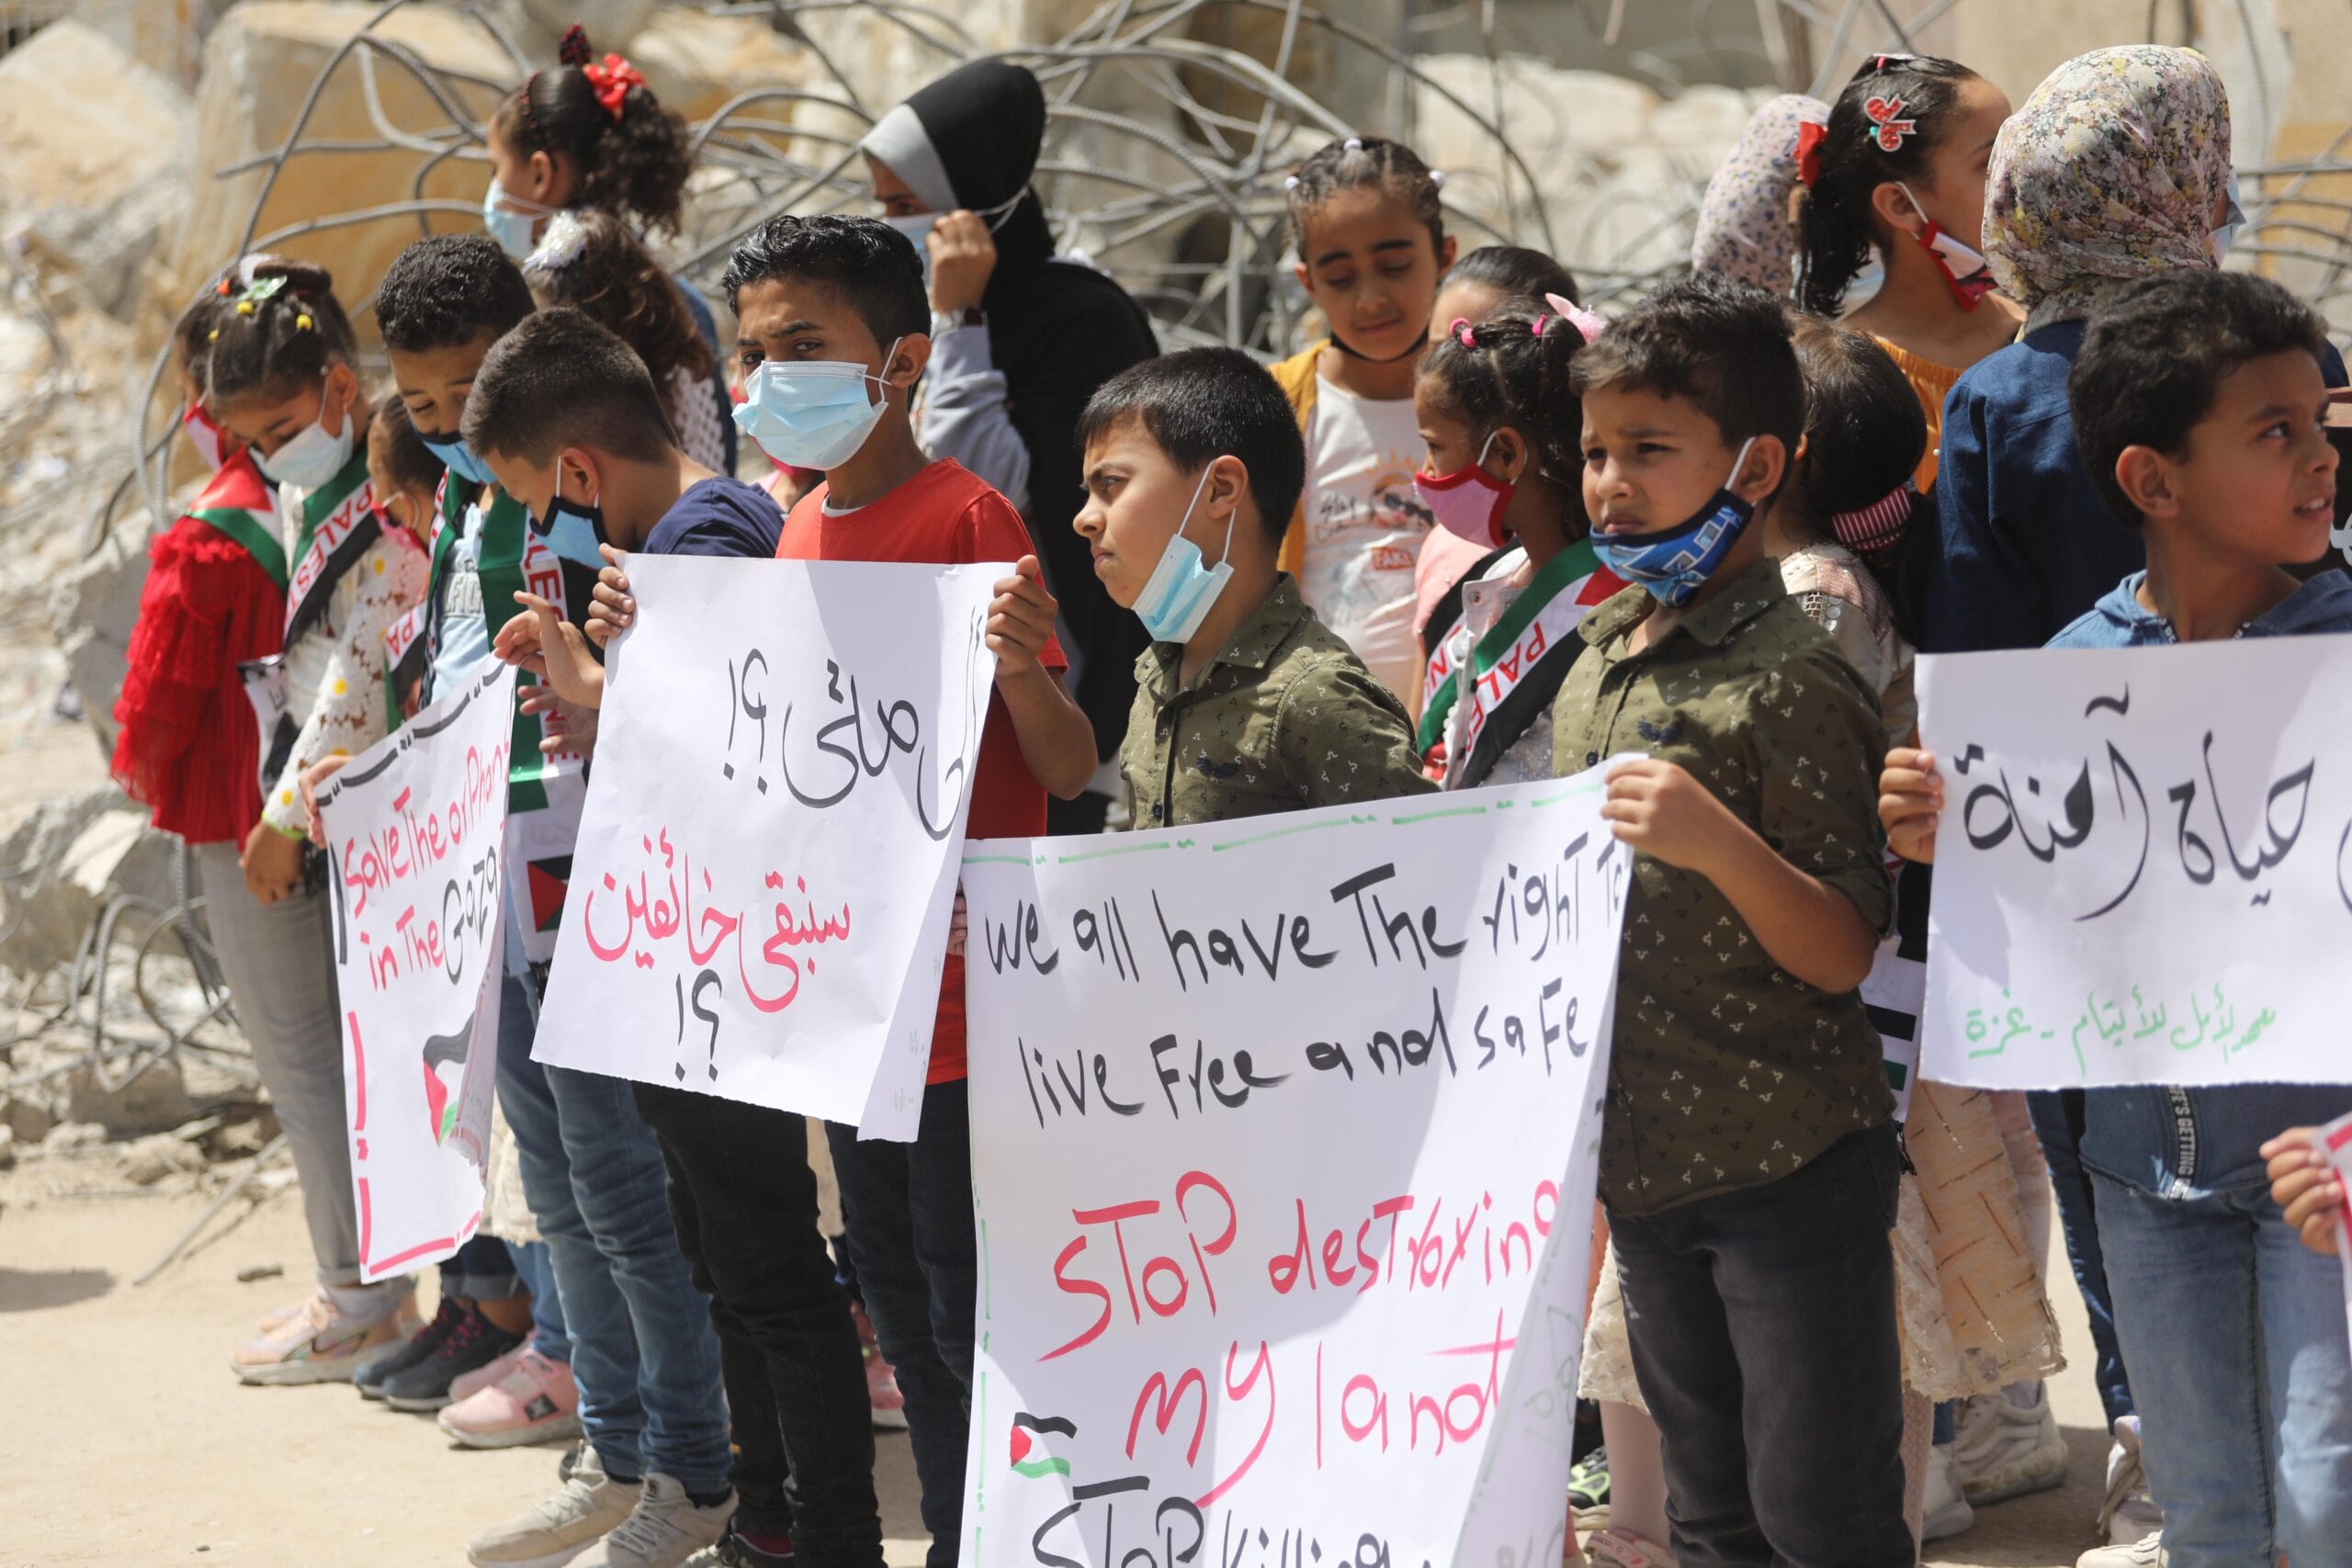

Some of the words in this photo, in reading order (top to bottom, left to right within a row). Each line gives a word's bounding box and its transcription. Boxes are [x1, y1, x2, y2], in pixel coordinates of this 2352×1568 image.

[782, 659, 920, 809] متى
[1954, 682, 2151, 922] آمنة
[2168, 729, 2315, 907] حياة
[584, 823, 738, 971] خائفين
[739, 870, 851, 1013] سنبقى
[1072, 896, 1139, 983] all
[1305, 986, 1457, 1081] and
[1965, 986, 2032, 1059] غزة
